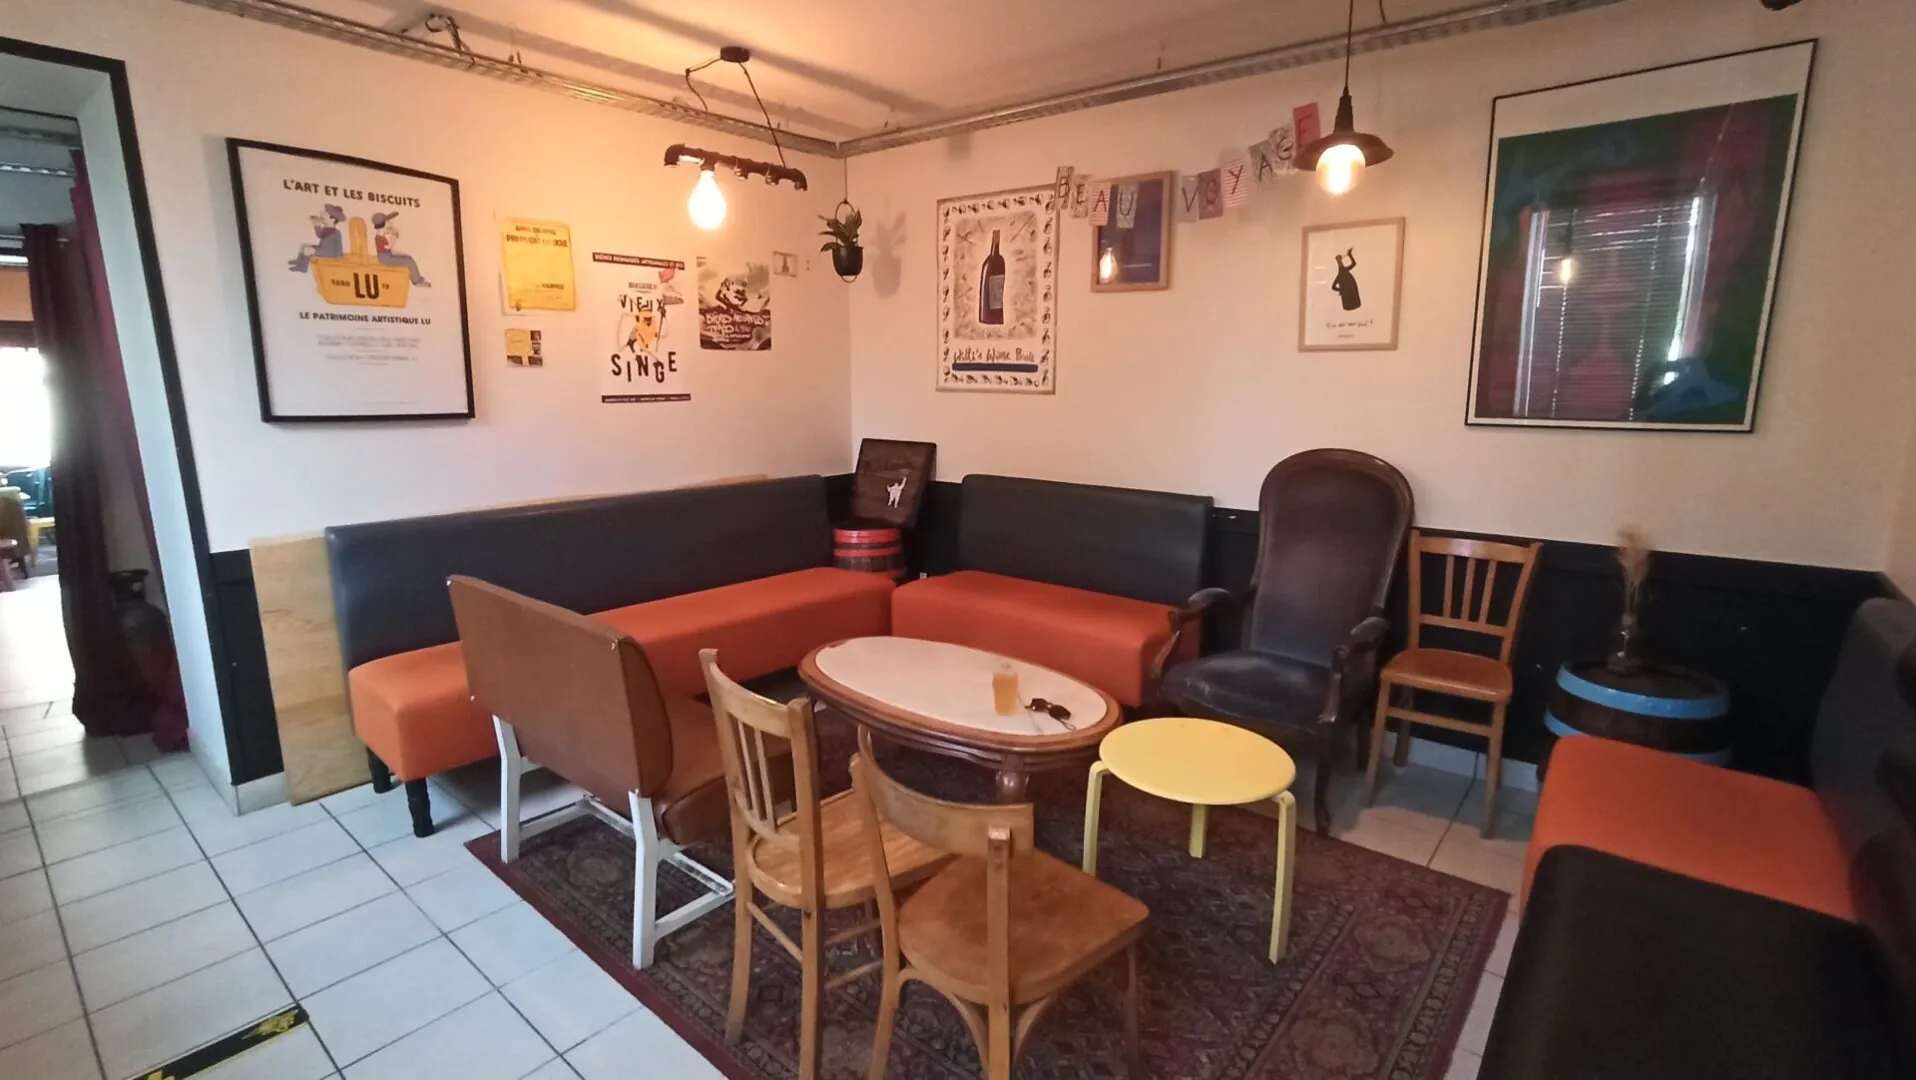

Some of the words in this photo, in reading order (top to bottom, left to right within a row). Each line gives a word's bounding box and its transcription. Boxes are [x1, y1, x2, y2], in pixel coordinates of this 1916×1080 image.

[1058, 175, 1135, 217] BEAU
[1181, 113, 1313, 213] VOYAGE
[283, 178, 320, 194] L'ART
[324, 185, 339, 197] ET
[343, 188, 363, 201] LES
[367, 191, 421, 208] BISCUITS
[352, 271, 380, 300] LU
[299, 311, 310, 320] LE
[312, 311, 369, 323] PATRIMOINE
[371, 315, 419, 325] ARTISTIQUE
[420, 317, 431, 326] LU
[610, 350, 678, 383] SINGE
